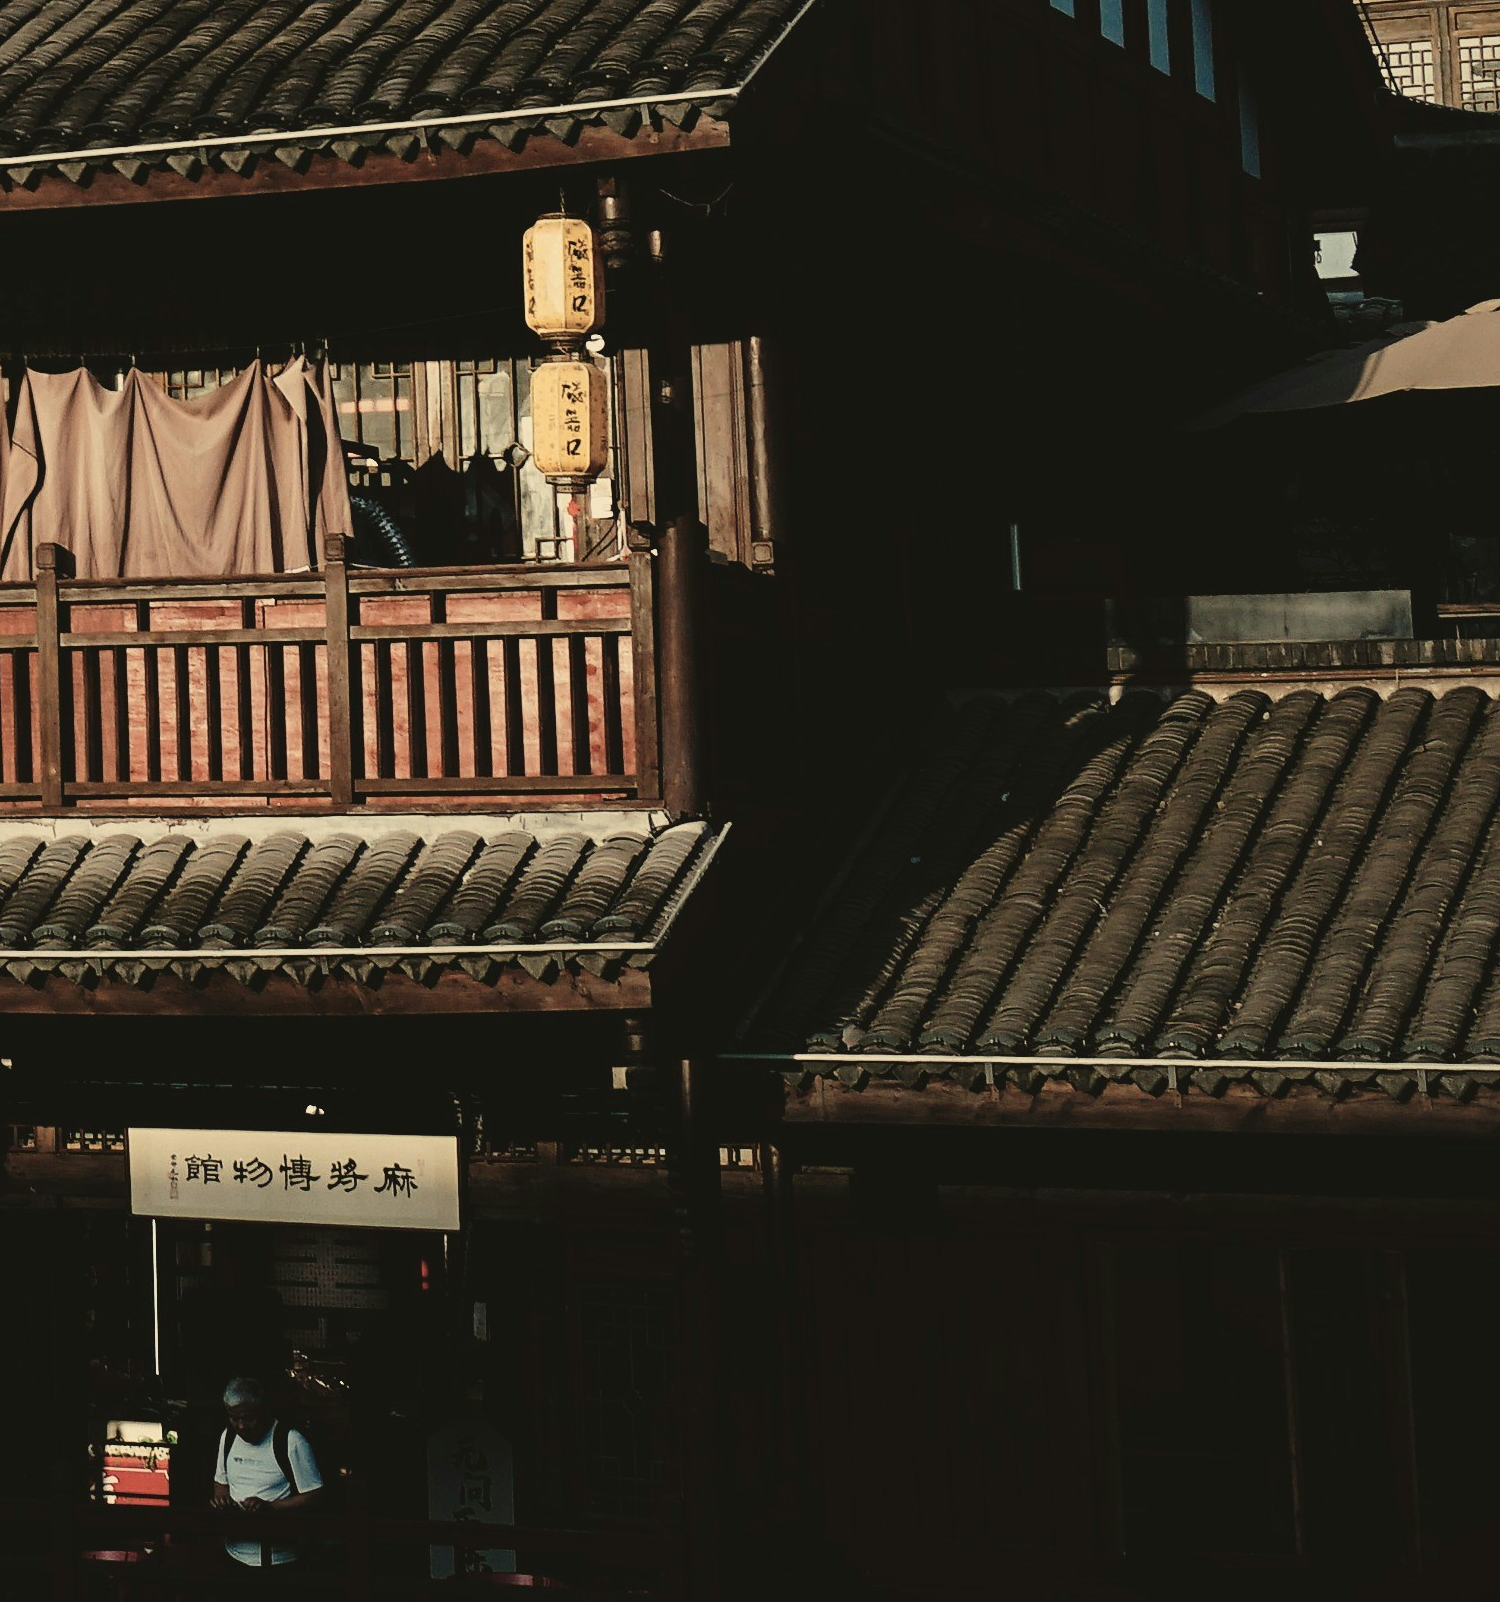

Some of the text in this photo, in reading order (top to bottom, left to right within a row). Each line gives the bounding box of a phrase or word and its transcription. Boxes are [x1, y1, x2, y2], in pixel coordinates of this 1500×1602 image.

[566, 238, 590, 313] 磁器口
[560, 381, 586, 456] 磁器口
